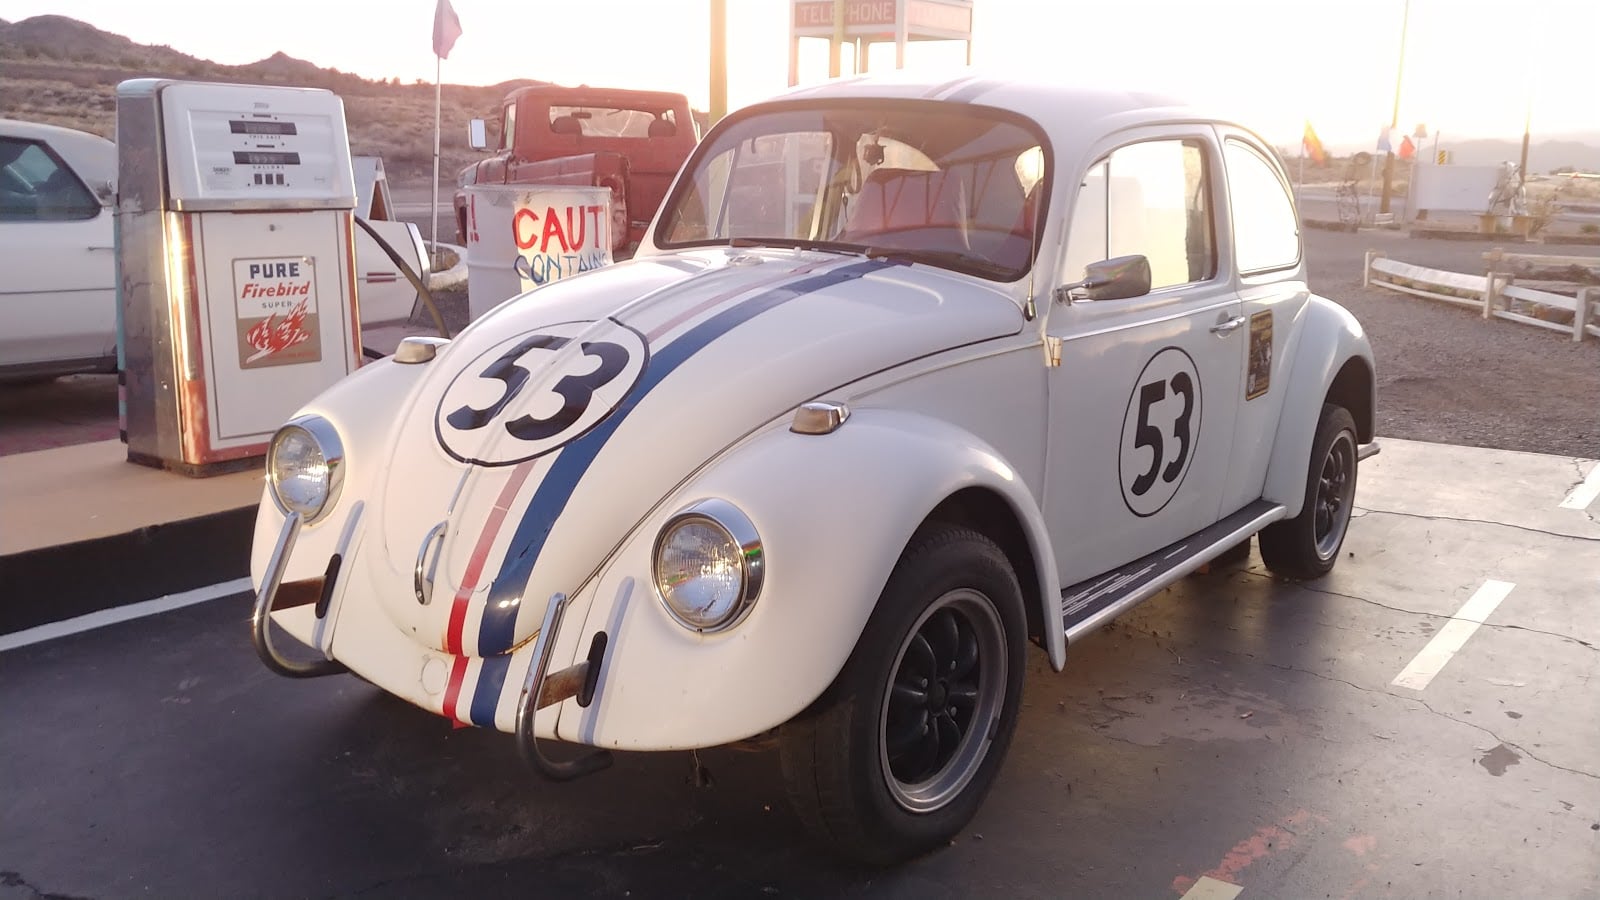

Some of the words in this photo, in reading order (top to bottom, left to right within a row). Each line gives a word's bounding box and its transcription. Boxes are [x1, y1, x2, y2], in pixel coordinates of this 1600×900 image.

[800, 2, 893, 24] TELHONE
[249, 262, 300, 279] PURE
[241, 281, 310, 299] Firebird
[262, 301, 292, 309] SUPER
[446, 334, 630, 441] 53
[1131, 371, 1194, 496] 53
